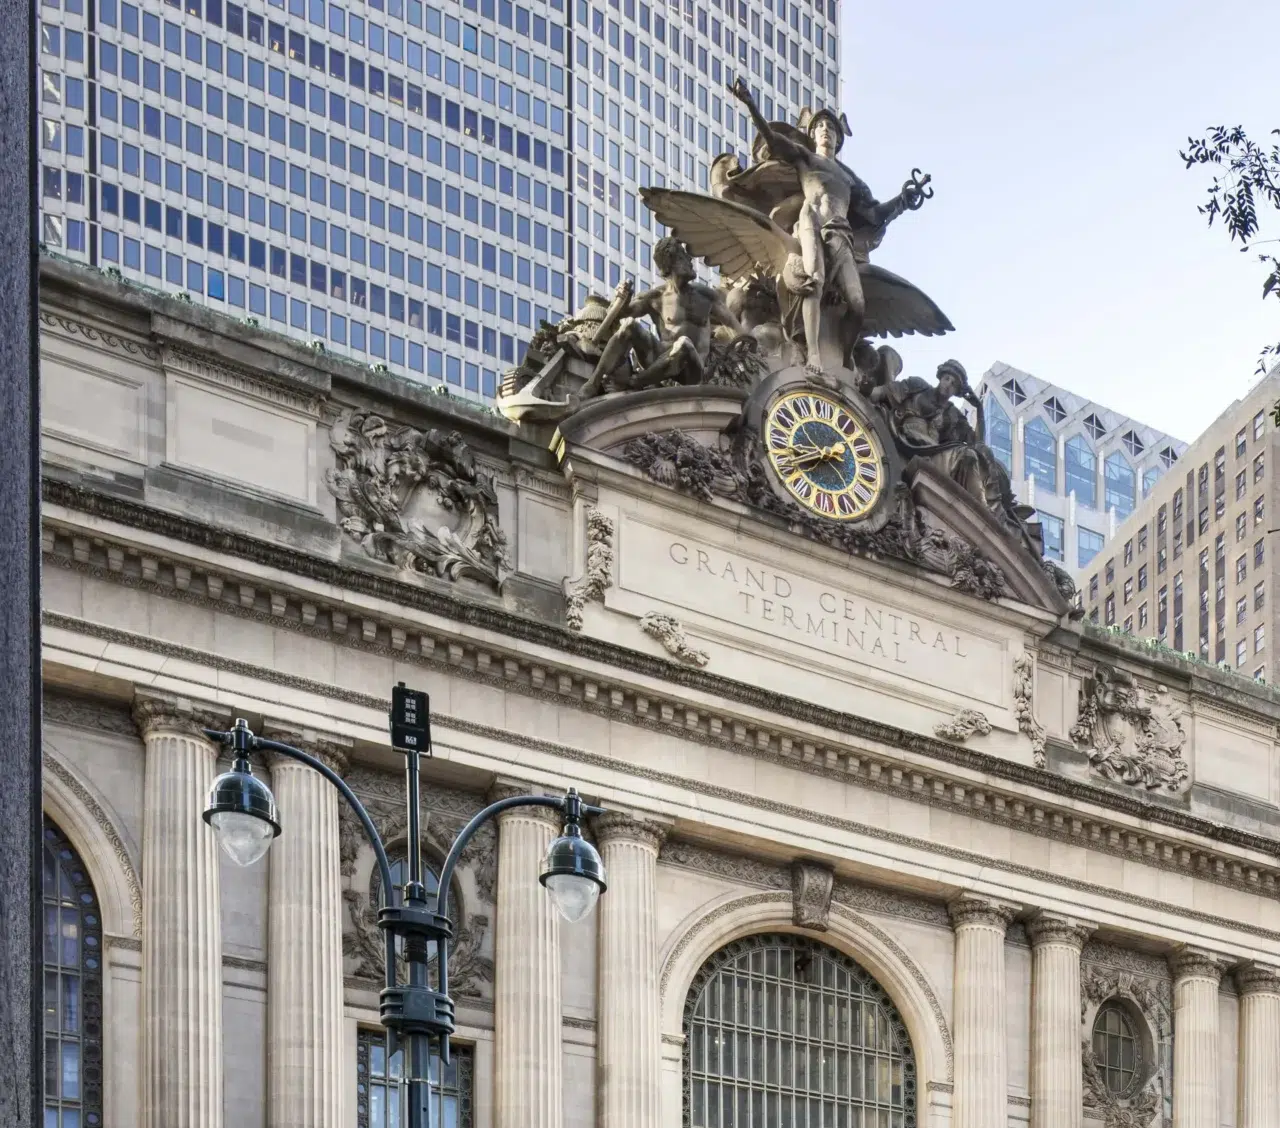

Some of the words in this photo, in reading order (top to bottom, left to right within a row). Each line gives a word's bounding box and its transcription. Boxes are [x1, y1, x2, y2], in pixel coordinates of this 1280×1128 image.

[669, 543, 792, 599] GRAND
[819, 592, 967, 658] CENTRAL
[739, 591, 907, 664] TERMINAL
